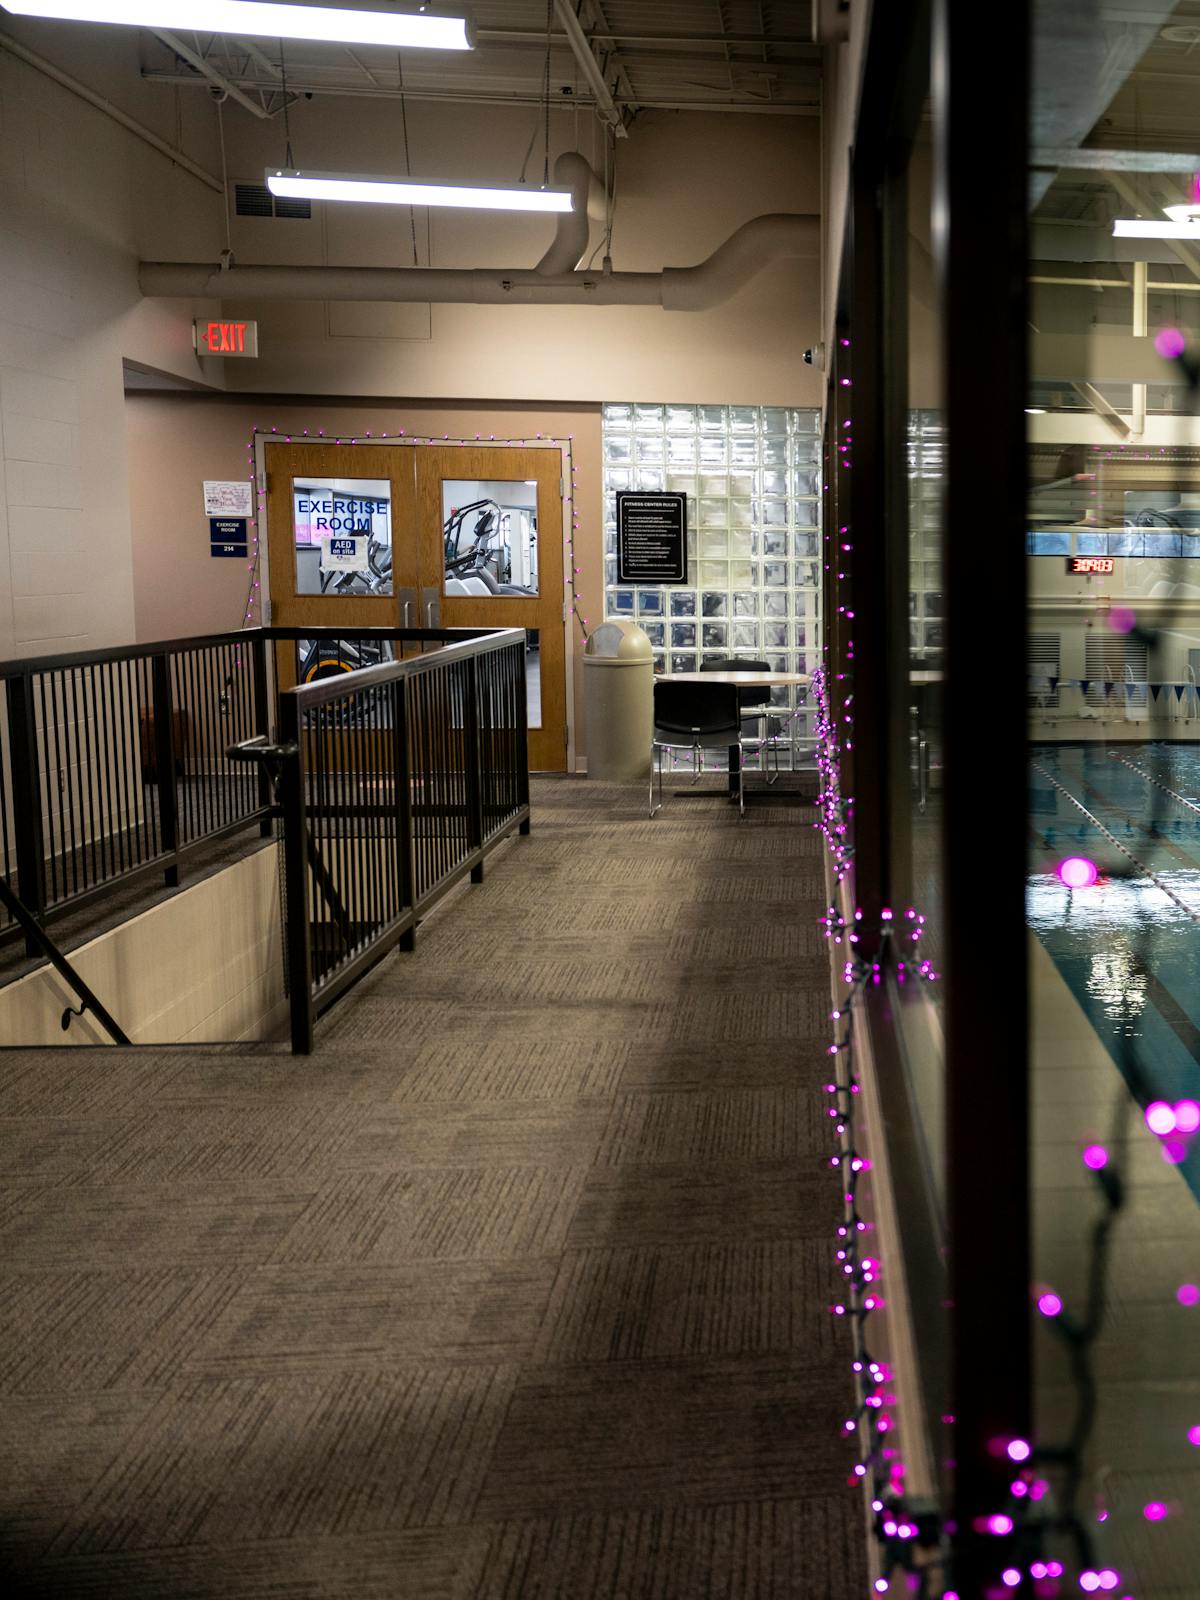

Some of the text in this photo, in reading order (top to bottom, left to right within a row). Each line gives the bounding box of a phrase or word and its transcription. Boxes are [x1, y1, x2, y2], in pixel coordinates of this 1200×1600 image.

[207, 323, 246, 352] EXIT
[299, 500, 387, 514] EXERCISE
[316, 517, 369, 530] ROOM
[335, 540, 352, 548] AED
